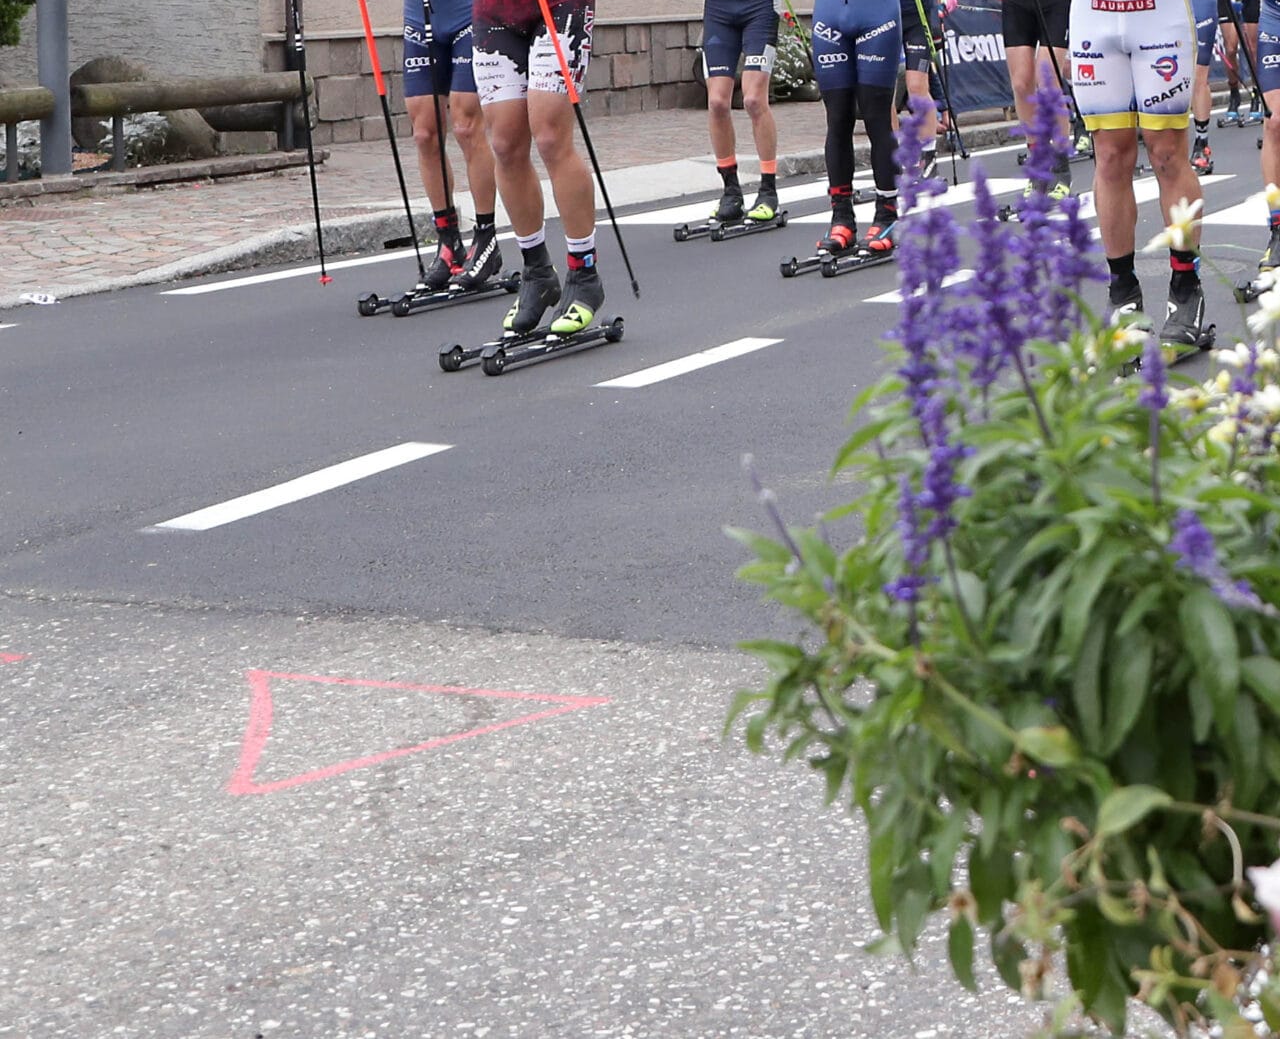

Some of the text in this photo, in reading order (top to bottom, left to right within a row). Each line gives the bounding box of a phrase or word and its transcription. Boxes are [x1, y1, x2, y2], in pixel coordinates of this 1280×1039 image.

[1092, 0, 1154, 11] BAUHAUS
[814, 21, 842, 42] EA7
[1143, 82, 1185, 108] CRAFT
